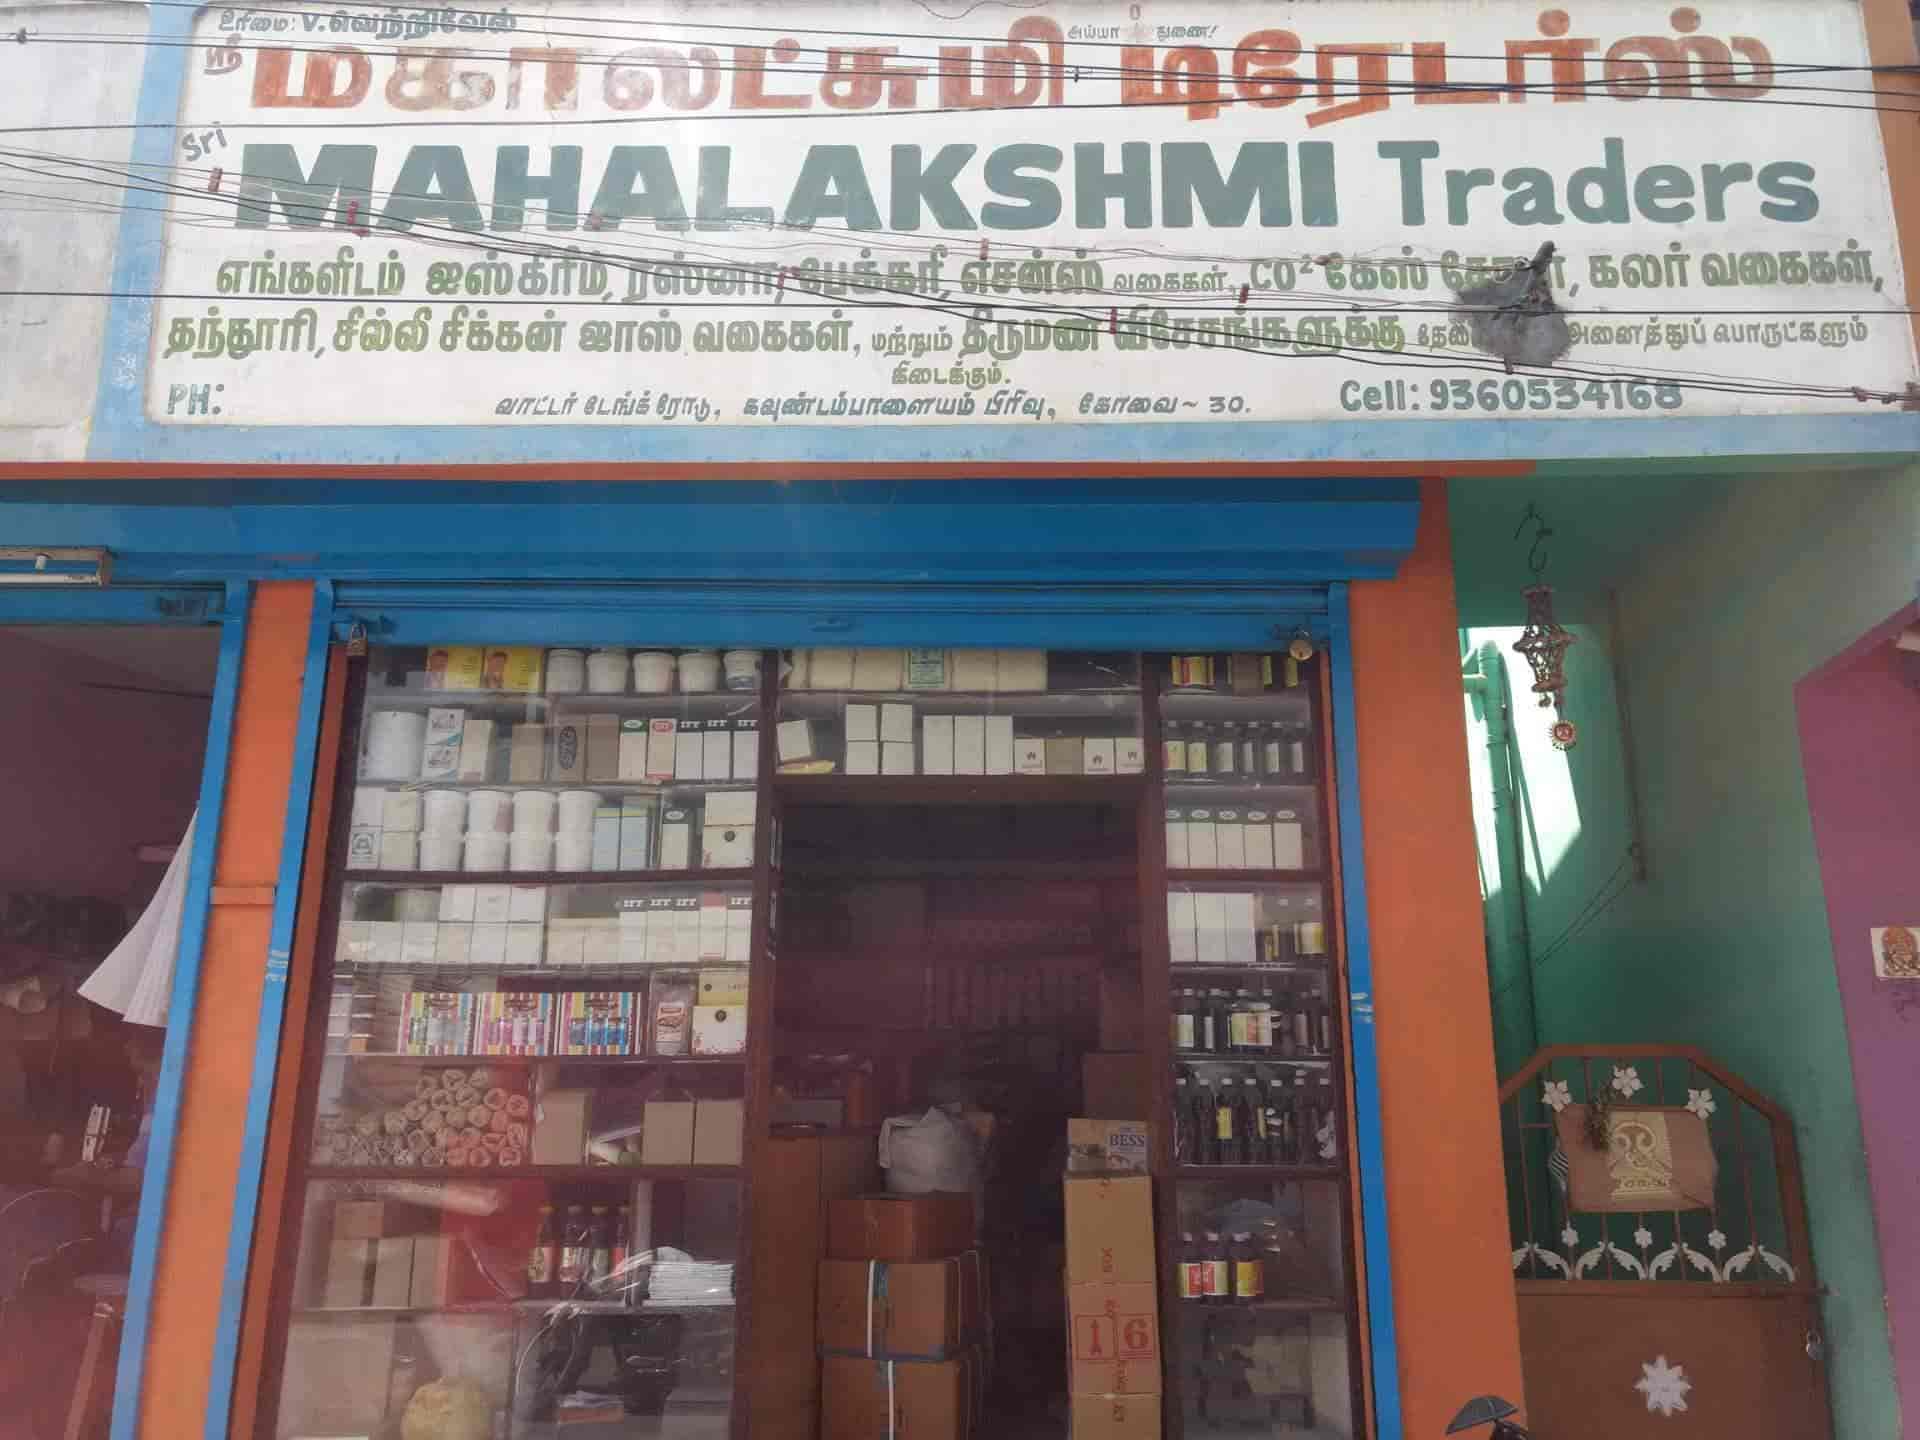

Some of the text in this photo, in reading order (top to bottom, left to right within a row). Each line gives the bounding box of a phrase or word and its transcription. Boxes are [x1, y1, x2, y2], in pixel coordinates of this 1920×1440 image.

[251, 15, 1064, 112] மகாலட்சுமி
[179, 122, 1821, 232] Sri MAHALAKSHMI Traders
[215, 246, 407, 296] எங்களிடம்
[1588, 241, 1690, 288] கலர்
[871, 324, 954, 359] மற்றும்
[166, 382, 225, 416] PH:
[1339, 378, 1683, 413] Cell: 9360534168
